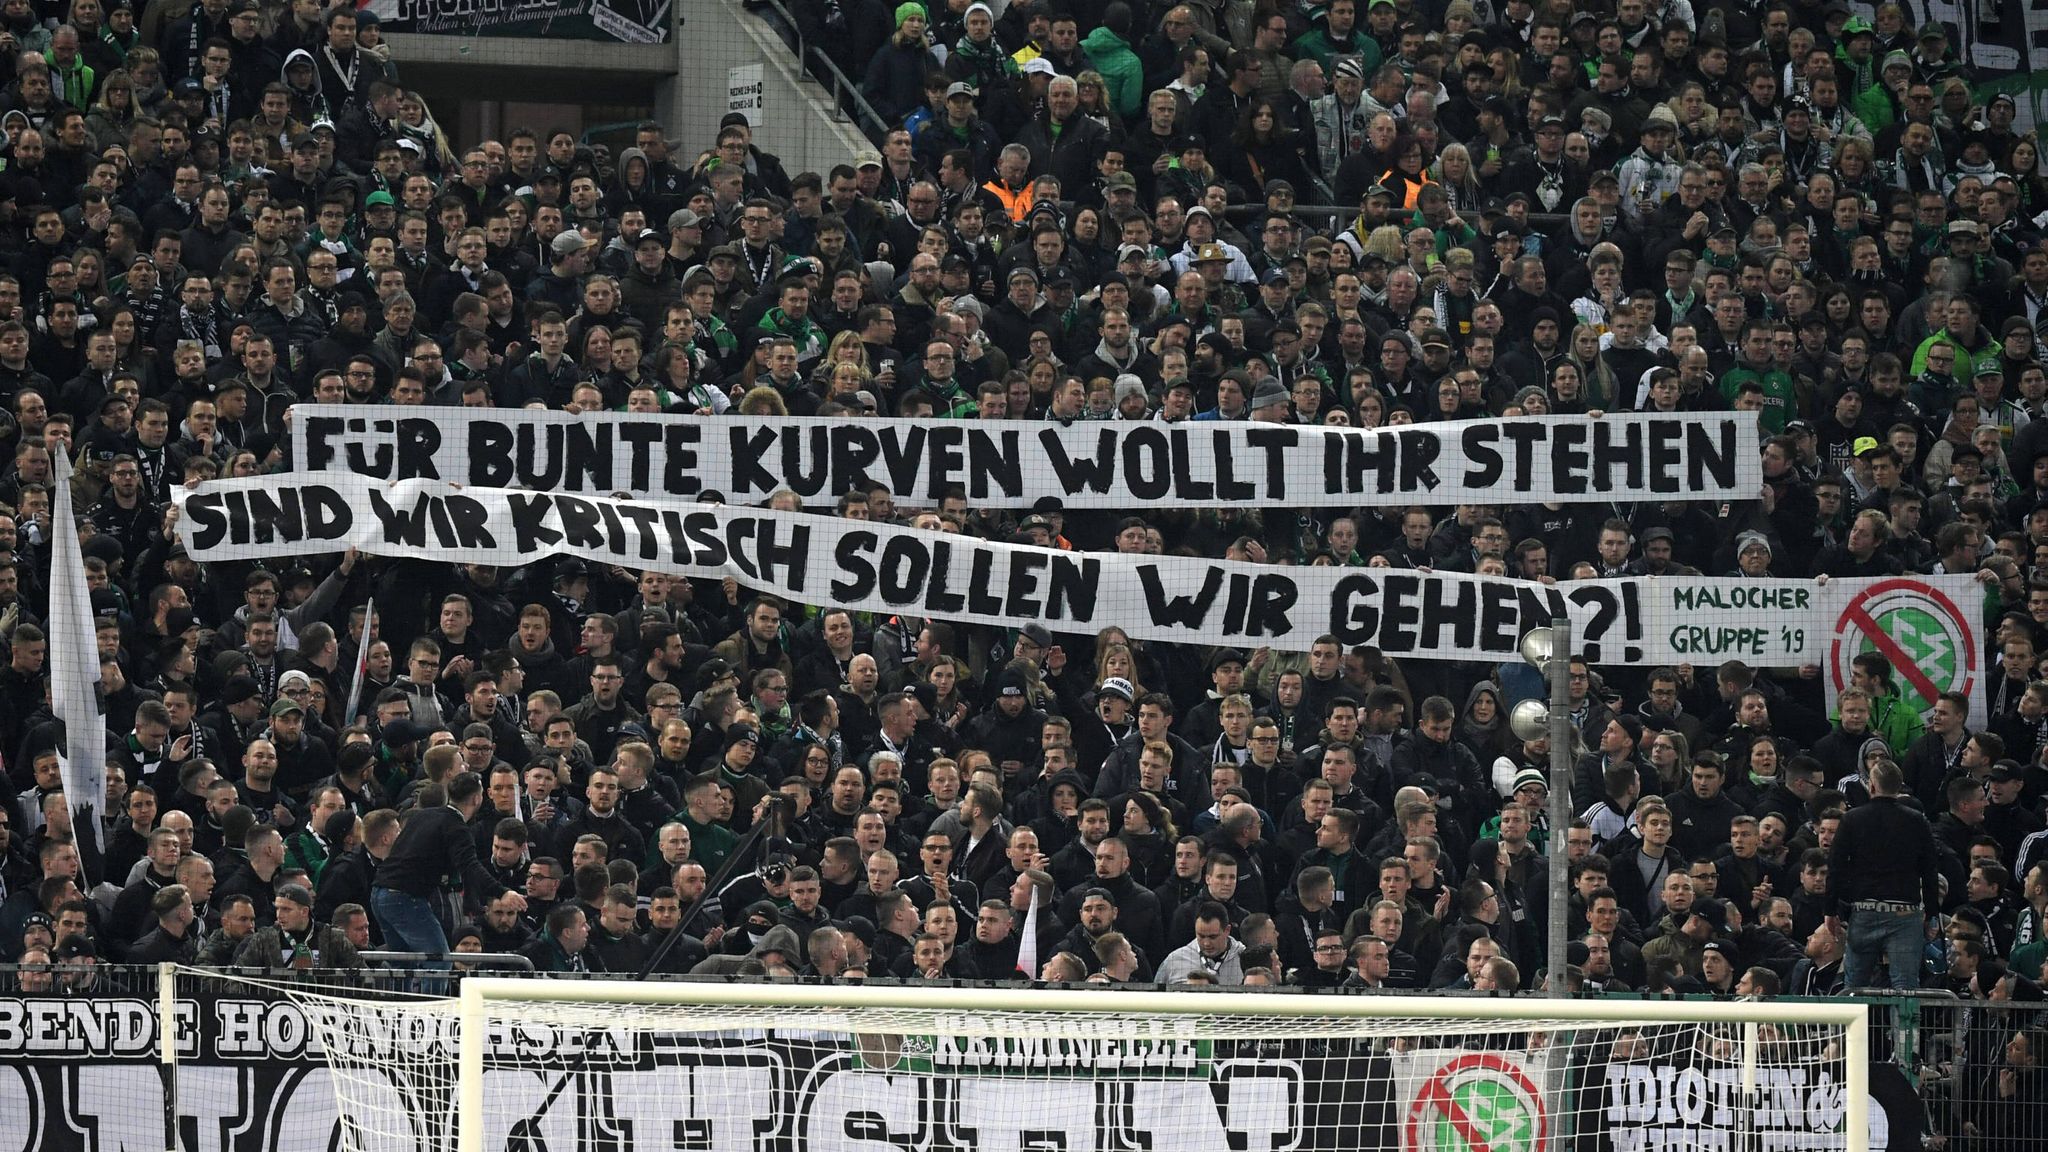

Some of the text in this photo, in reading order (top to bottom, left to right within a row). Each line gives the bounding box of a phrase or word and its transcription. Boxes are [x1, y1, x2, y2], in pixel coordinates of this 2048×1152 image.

[306, 416, 1737, 501] FÜR BUNTE KURVEN WOLLT IHR STEHEN
[185, 485, 354, 550] SIND
[368, 488, 498, 549] WIR
[507, 493, 811, 594] KRITISCH
[830, 531, 1103, 623] SOLLEN
[1136, 564, 1299, 638] WIR
[1674, 586, 1810, 611] MALOCHER
[1670, 625, 1768, 655] GRUPPE
[935, 1017, 1197, 1068] KRIMINELLE
[1607, 1065, 1806, 1127] IDIOTEN
